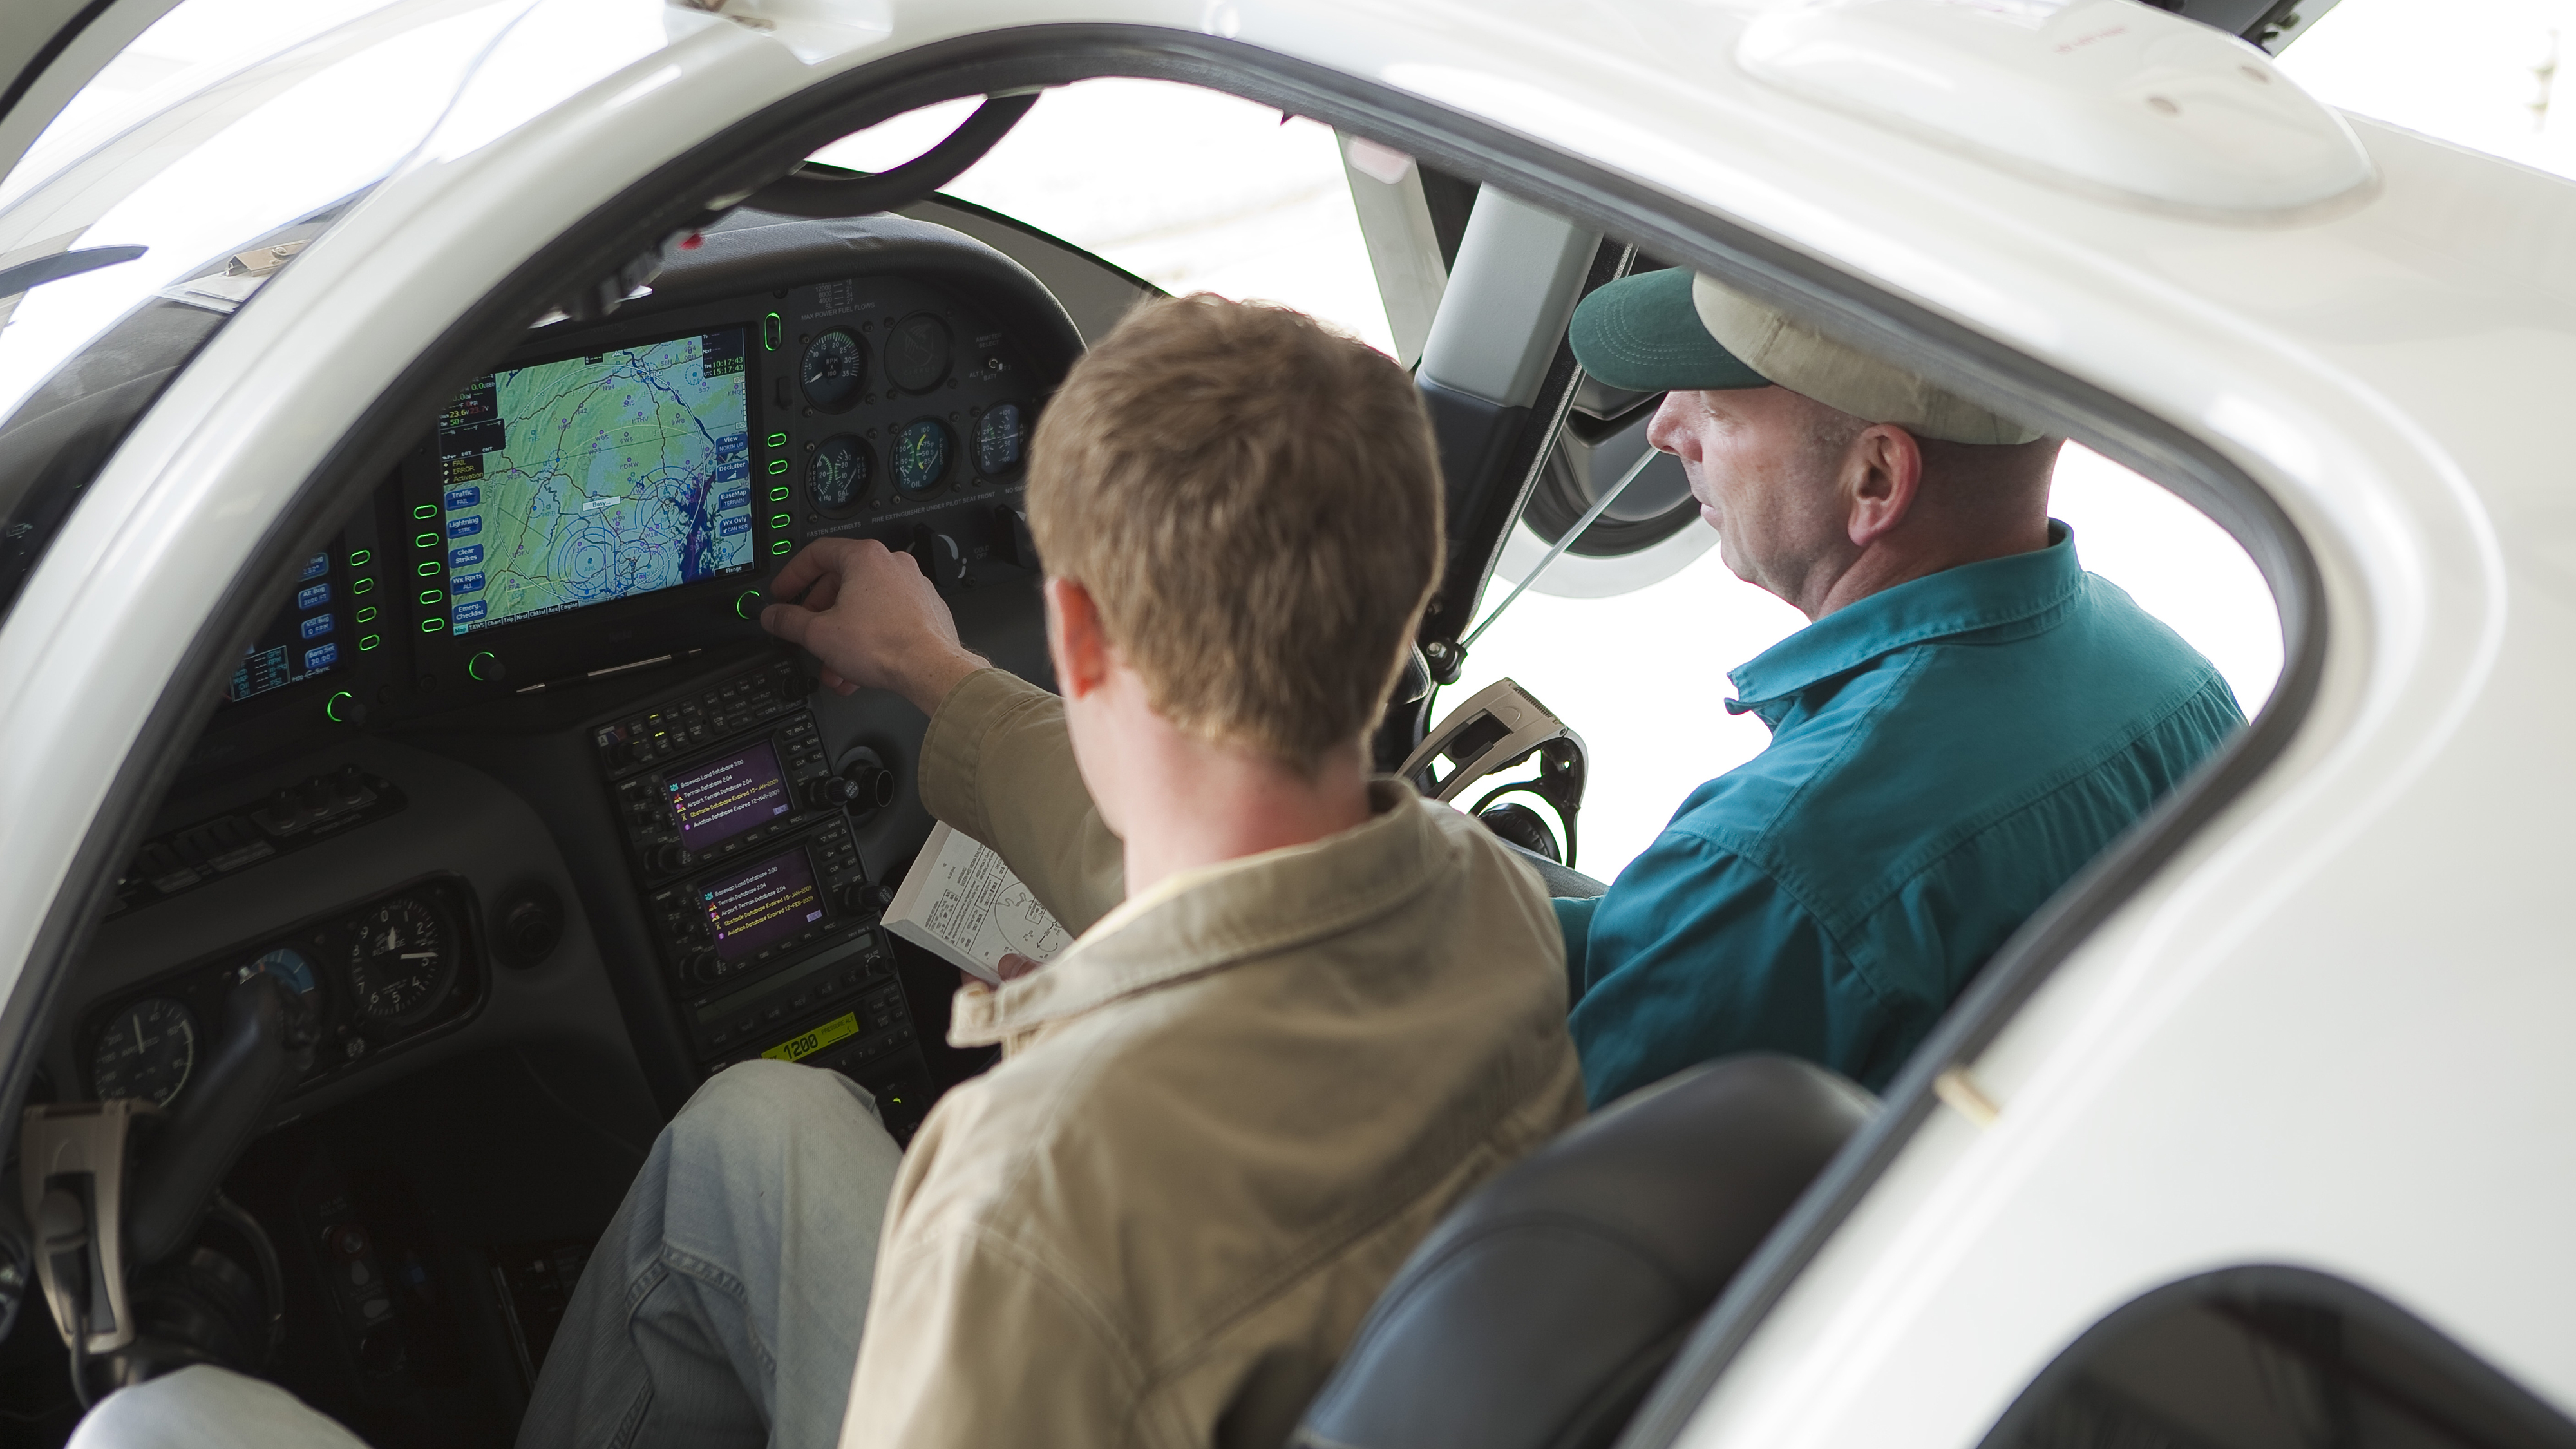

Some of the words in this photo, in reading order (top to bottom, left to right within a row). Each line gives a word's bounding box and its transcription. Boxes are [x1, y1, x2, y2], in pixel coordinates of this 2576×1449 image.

[815, 309, 837, 318] POWER
[854, 302, 875, 311] FLOWS
[976, 333, 1002, 343] AMMETER
[979, 340, 999, 348] SELECT
[712, 356, 743, 368] 10:17:43
[713, 365, 744, 376] 15:17:43
[450, 410, 466, 418] 23.6
[453, 465, 475, 475] ERROR
[719, 462, 746, 472] Declutter
[453, 472, 484, 482] Activation
[452, 489, 473, 498] Traffic
[721, 490, 747, 500] BaseMap
[724, 498, 744, 506] TERRAIN
[885, 507, 925, 521] EXTINGUISHER
[926, 503, 945, 512] UNDER
[962, 495, 976, 504] SEAT
[978, 491, 996, 500] FRONT
[449, 517, 479, 528] Lightning
[806, 526, 829, 538] FASTEN
[829, 522, 862, 533] SEATBELTS
[974, 545, 990, 554] COLD
[455, 555, 477, 564] Strikes
[458, 604, 482, 613] Emerg.
[561, 602, 578, 611] Engine
[456, 609, 484, 620] Checklist
[712, 764, 734, 776] Database
[683, 788, 701, 798] Terrain
[701, 779, 723, 791] Database
[687, 797, 705, 808] Airport
[704, 791, 721, 801] Terrain
[720, 782, 742, 795] Database
[732, 790, 750, 802] Expired
[712, 808, 734, 820] Database
[746, 872, 768, 883] Database
[718, 896, 735, 906] Terrain
[735, 887, 757, 900] Database
[882, 888, 892, 899] PUSH
[721, 905, 738, 916] Airport
[738, 899, 755, 909] Terrain
[754, 891, 776, 902] Database
[766, 898, 783, 909] Expired
[380, 909, 389, 922] 0
[404, 910, 409, 922] 1
[745, 916, 767, 929] Database
[767, 907, 784, 919] Expired
[360, 926, 369, 940] 9
[416, 922, 424, 935] 2
[352, 944, 360, 956] 8
[357, 981, 365, 994] 7
[412, 976, 421, 987] 4
[370, 992, 379, 1004] 6
[392, 991, 401, 1004] 5
[821, 1021, 846, 1035] PRESSURE
[845, 1015, 853, 1023] ALT
[783, 1034, 819, 1059] 1200
